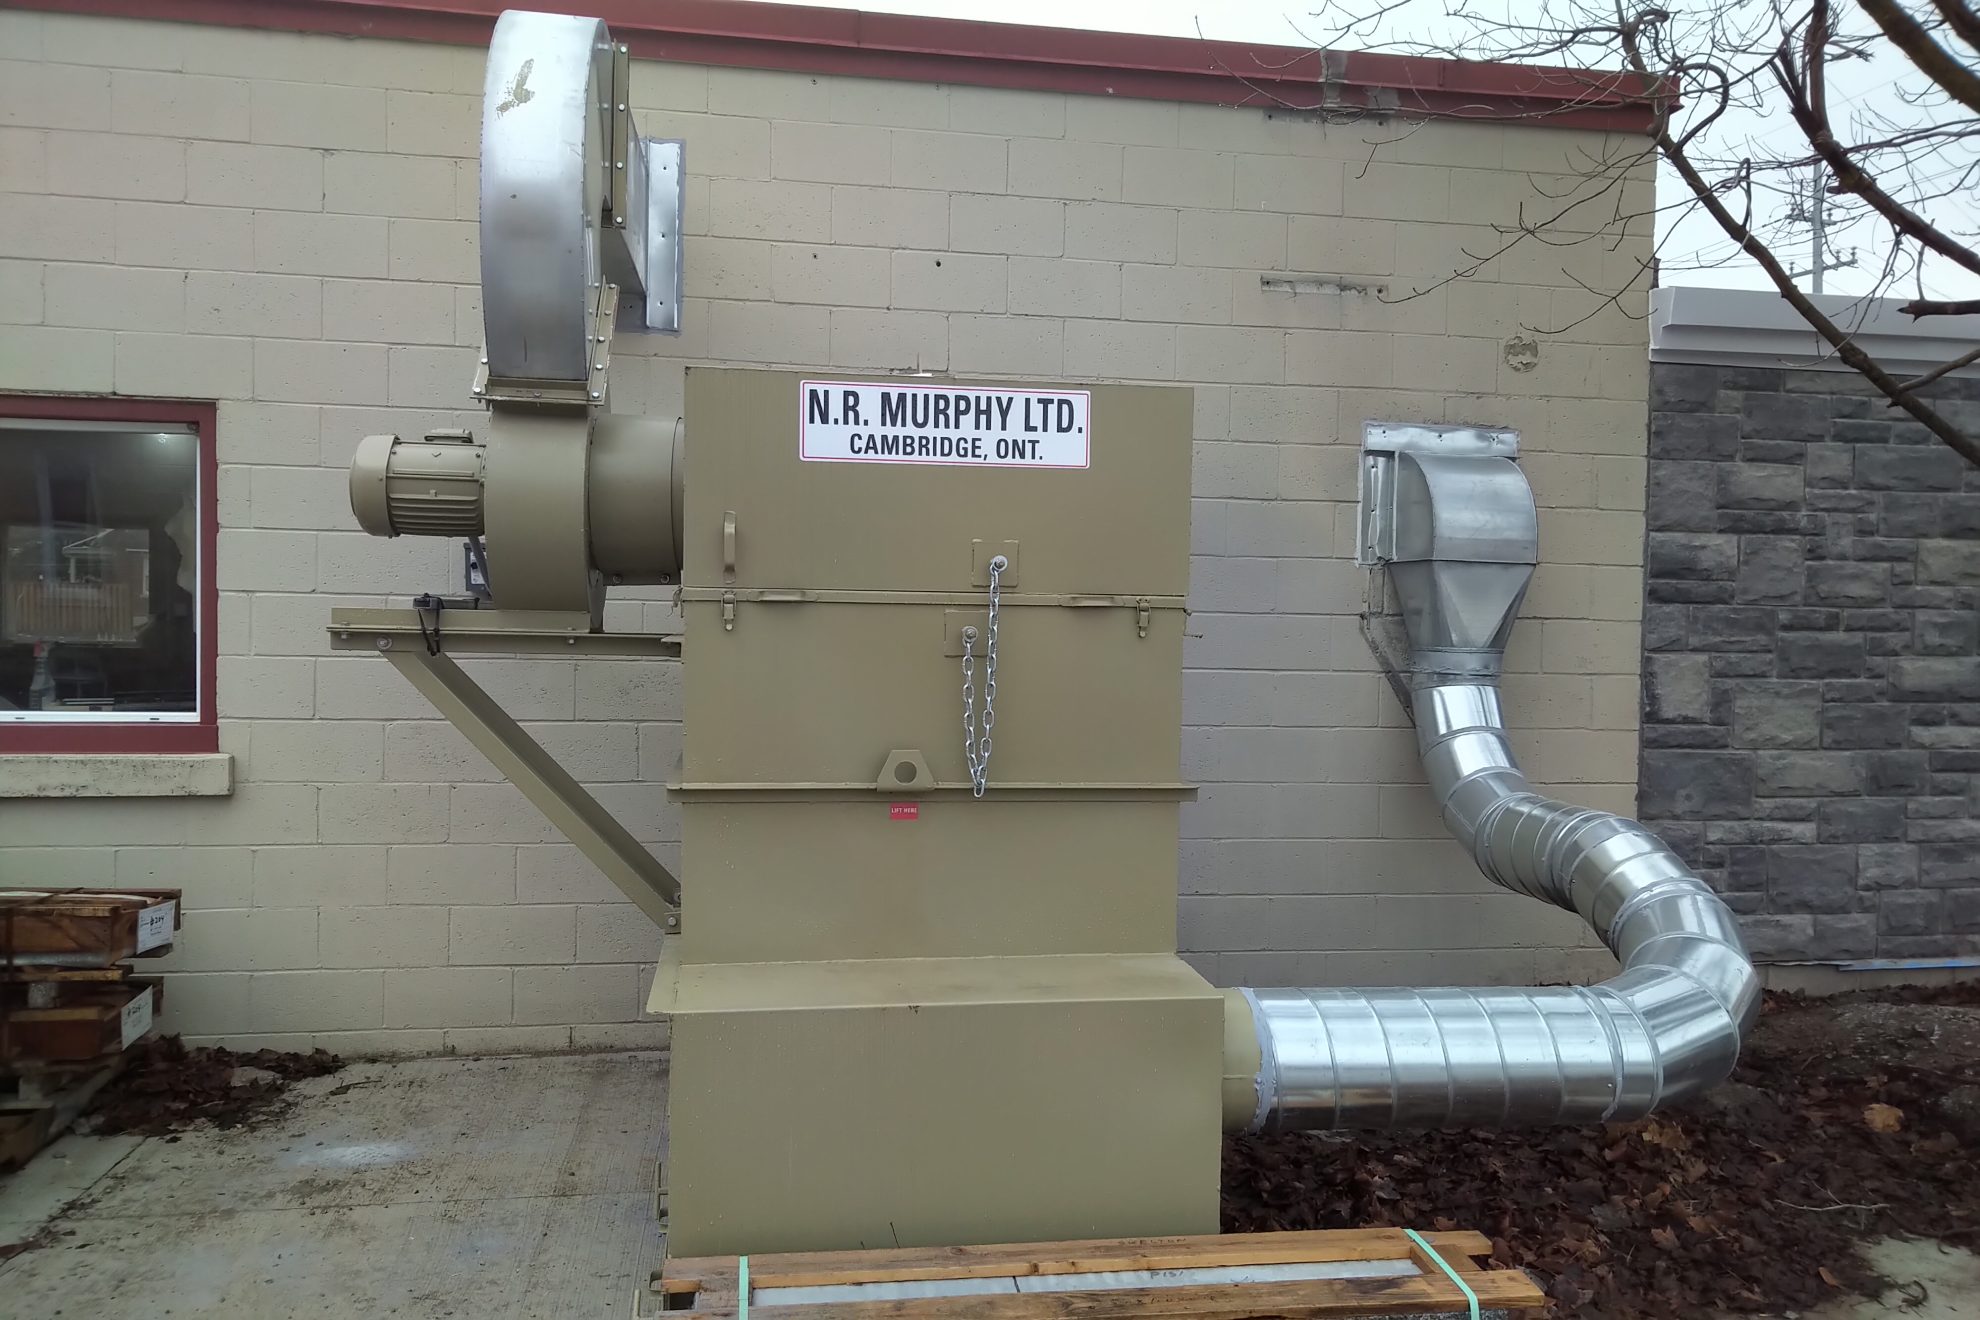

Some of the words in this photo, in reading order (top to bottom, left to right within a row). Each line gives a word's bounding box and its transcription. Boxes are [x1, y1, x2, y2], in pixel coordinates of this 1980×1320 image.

[808, 388, 869, 426] N.R.
[880, 391, 1014, 431] MURPHY
[1023, 397, 1083, 434] LTD.
[849, 433, 988, 461] CAMBRIDGE,
[995, 438, 1043, 461] ONT.
